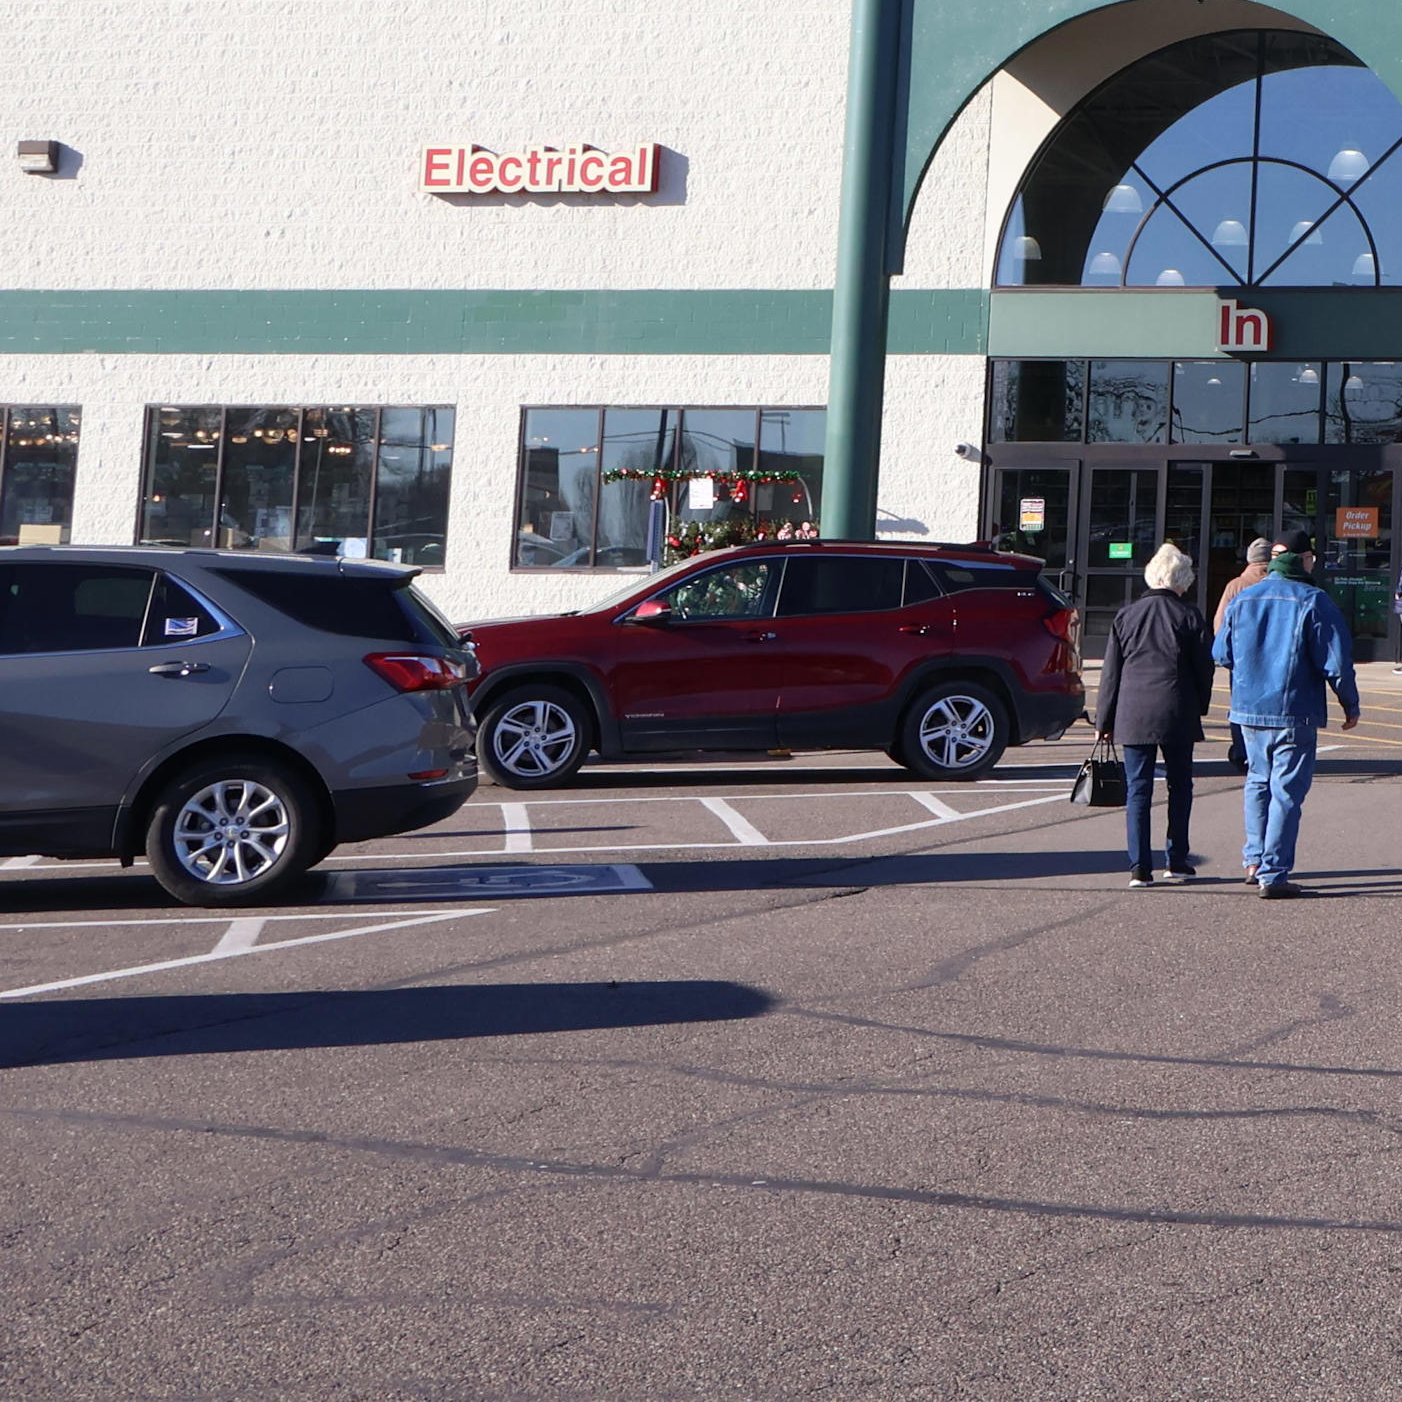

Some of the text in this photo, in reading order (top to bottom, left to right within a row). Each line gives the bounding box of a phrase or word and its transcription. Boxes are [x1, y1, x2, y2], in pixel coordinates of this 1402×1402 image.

[423, 147, 648, 187] Electrical
[1220, 304, 1262, 346] In
[1342, 521, 1372, 531] Pickup
[1345, 511, 1370, 520] Order
